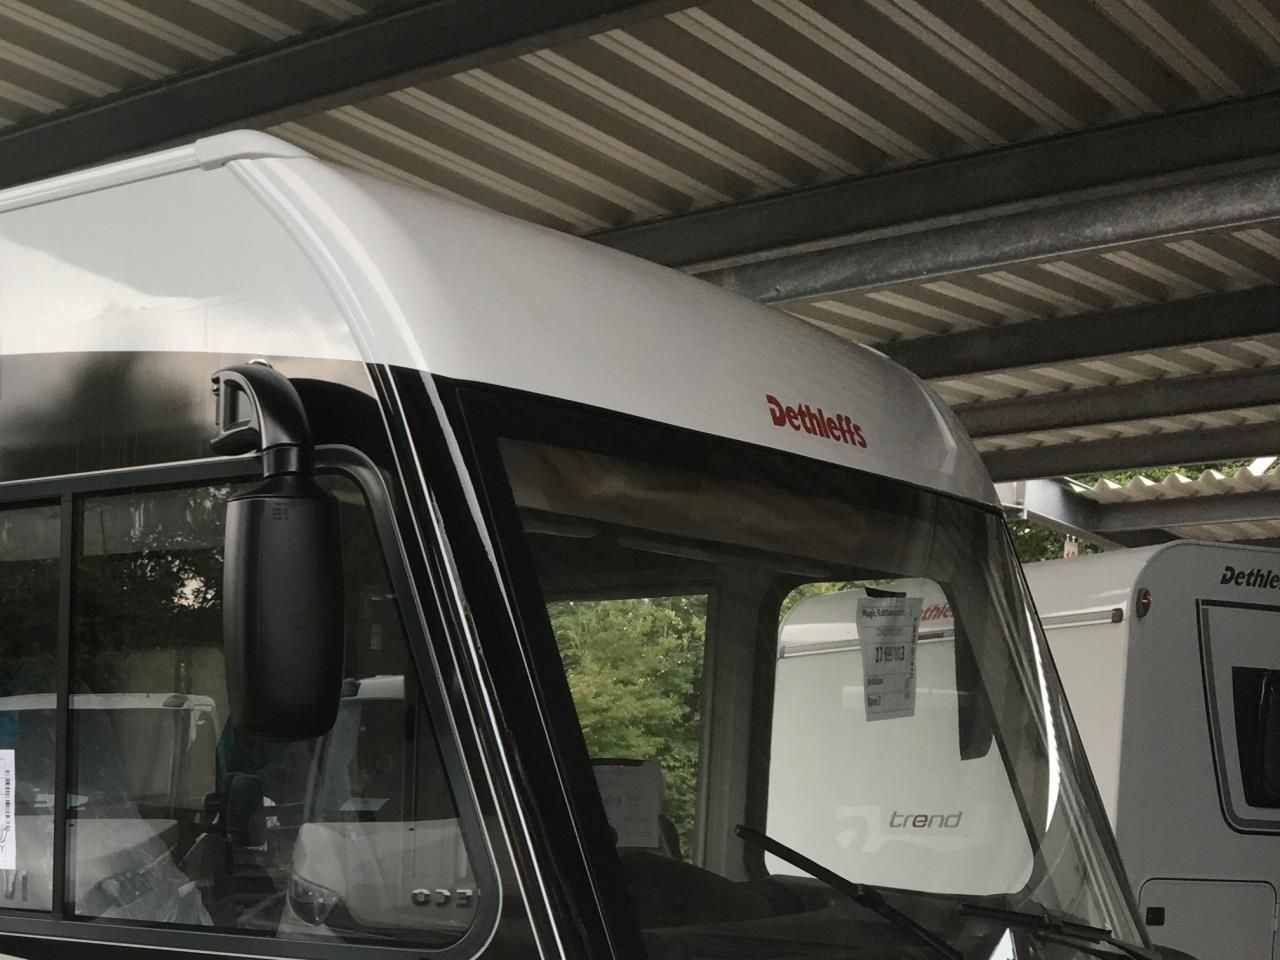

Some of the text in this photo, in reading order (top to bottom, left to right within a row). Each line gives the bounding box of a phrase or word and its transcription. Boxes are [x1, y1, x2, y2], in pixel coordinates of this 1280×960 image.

[766, 394, 868, 449] Dethleffs
[1220, 565, 1280, 589] Dethle
[889, 811, 963, 828] trend
